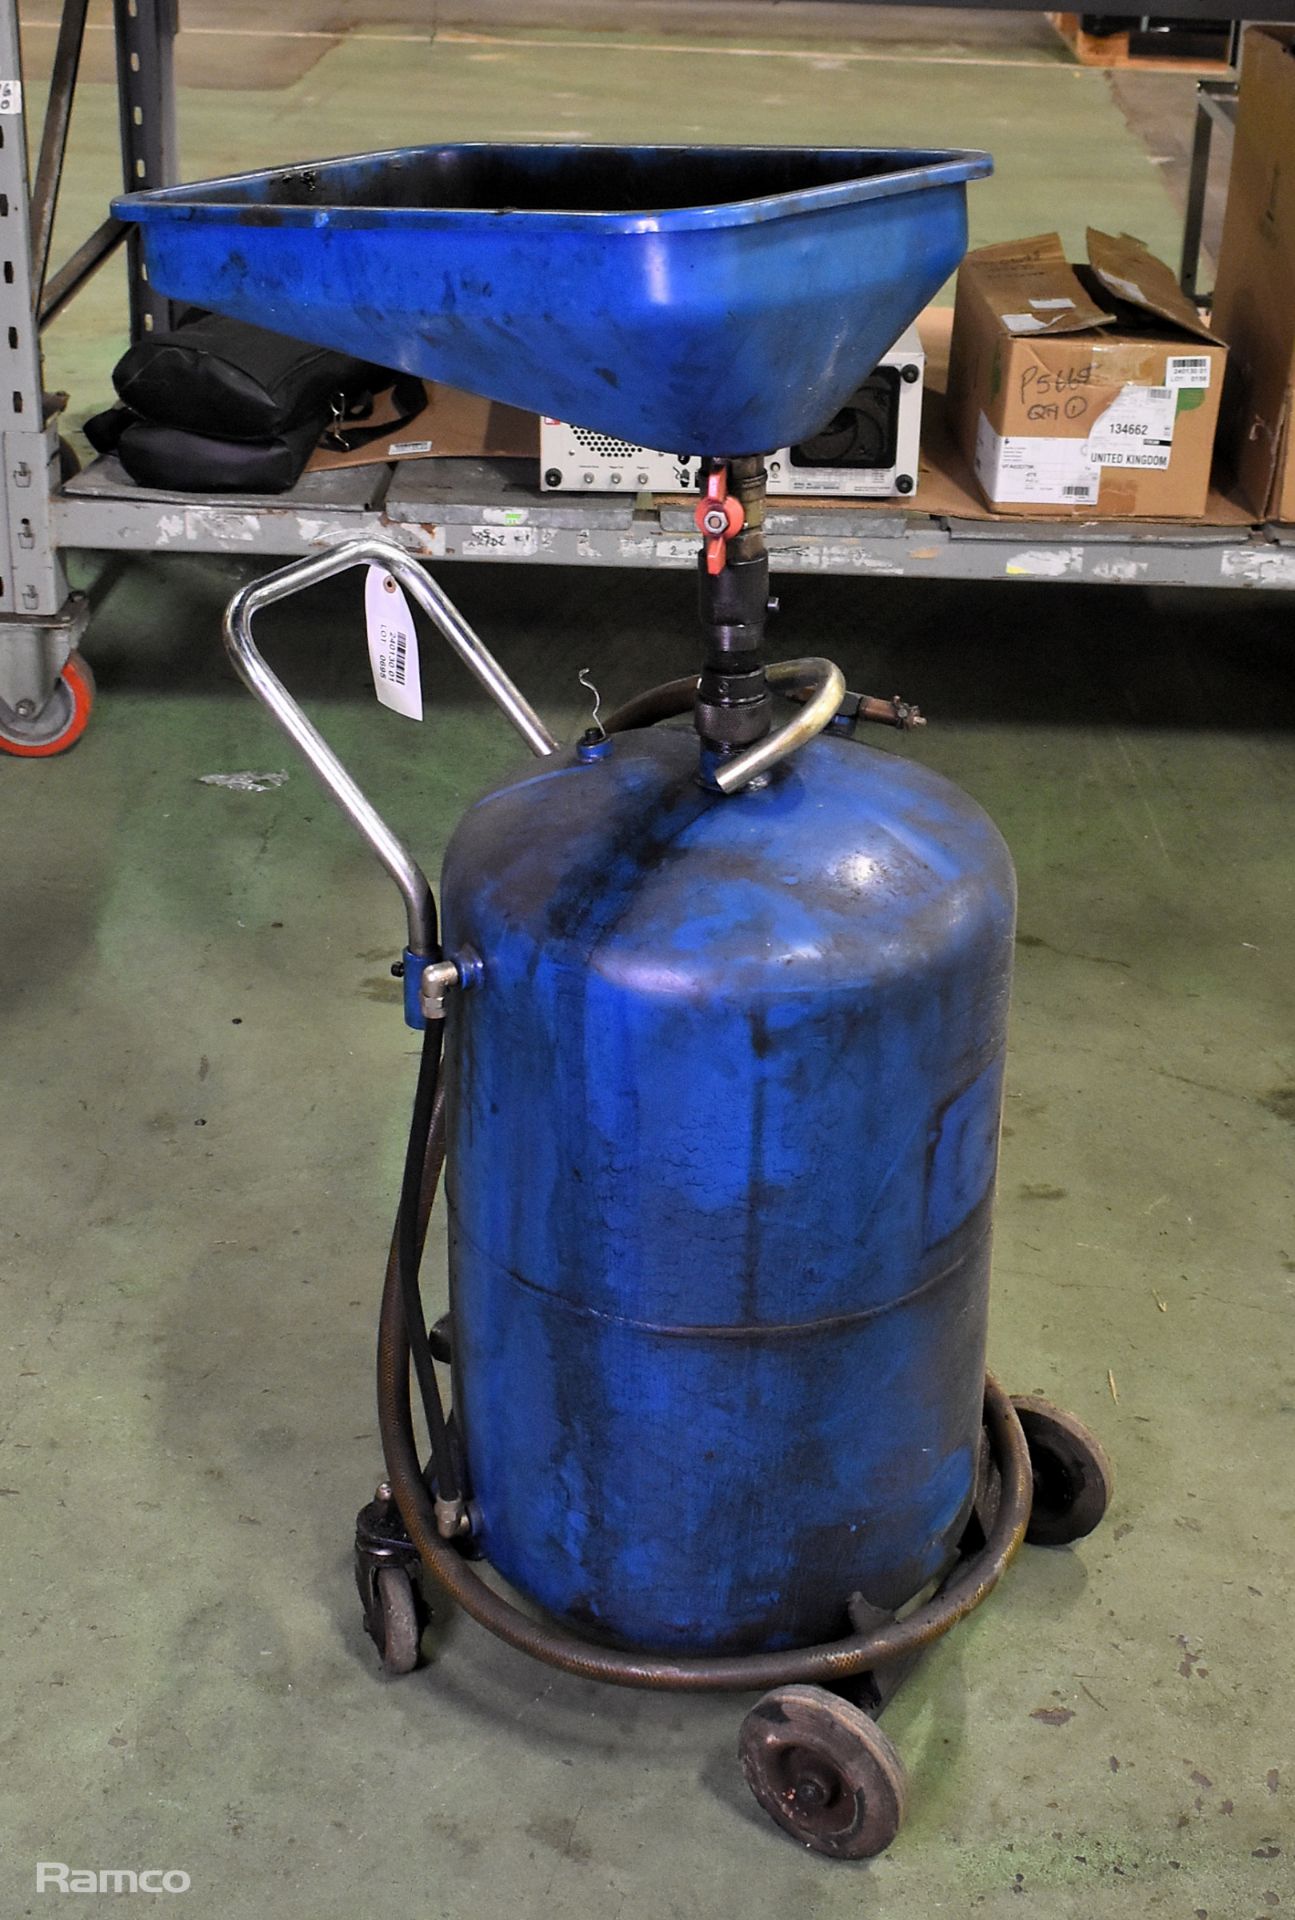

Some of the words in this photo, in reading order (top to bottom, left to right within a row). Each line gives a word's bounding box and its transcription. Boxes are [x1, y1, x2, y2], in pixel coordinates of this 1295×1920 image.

[1109, 423, 1149, 436] 134662
[1091, 452, 1124, 465] UNITED
[1125, 454, 1168, 466] KINGDOM
